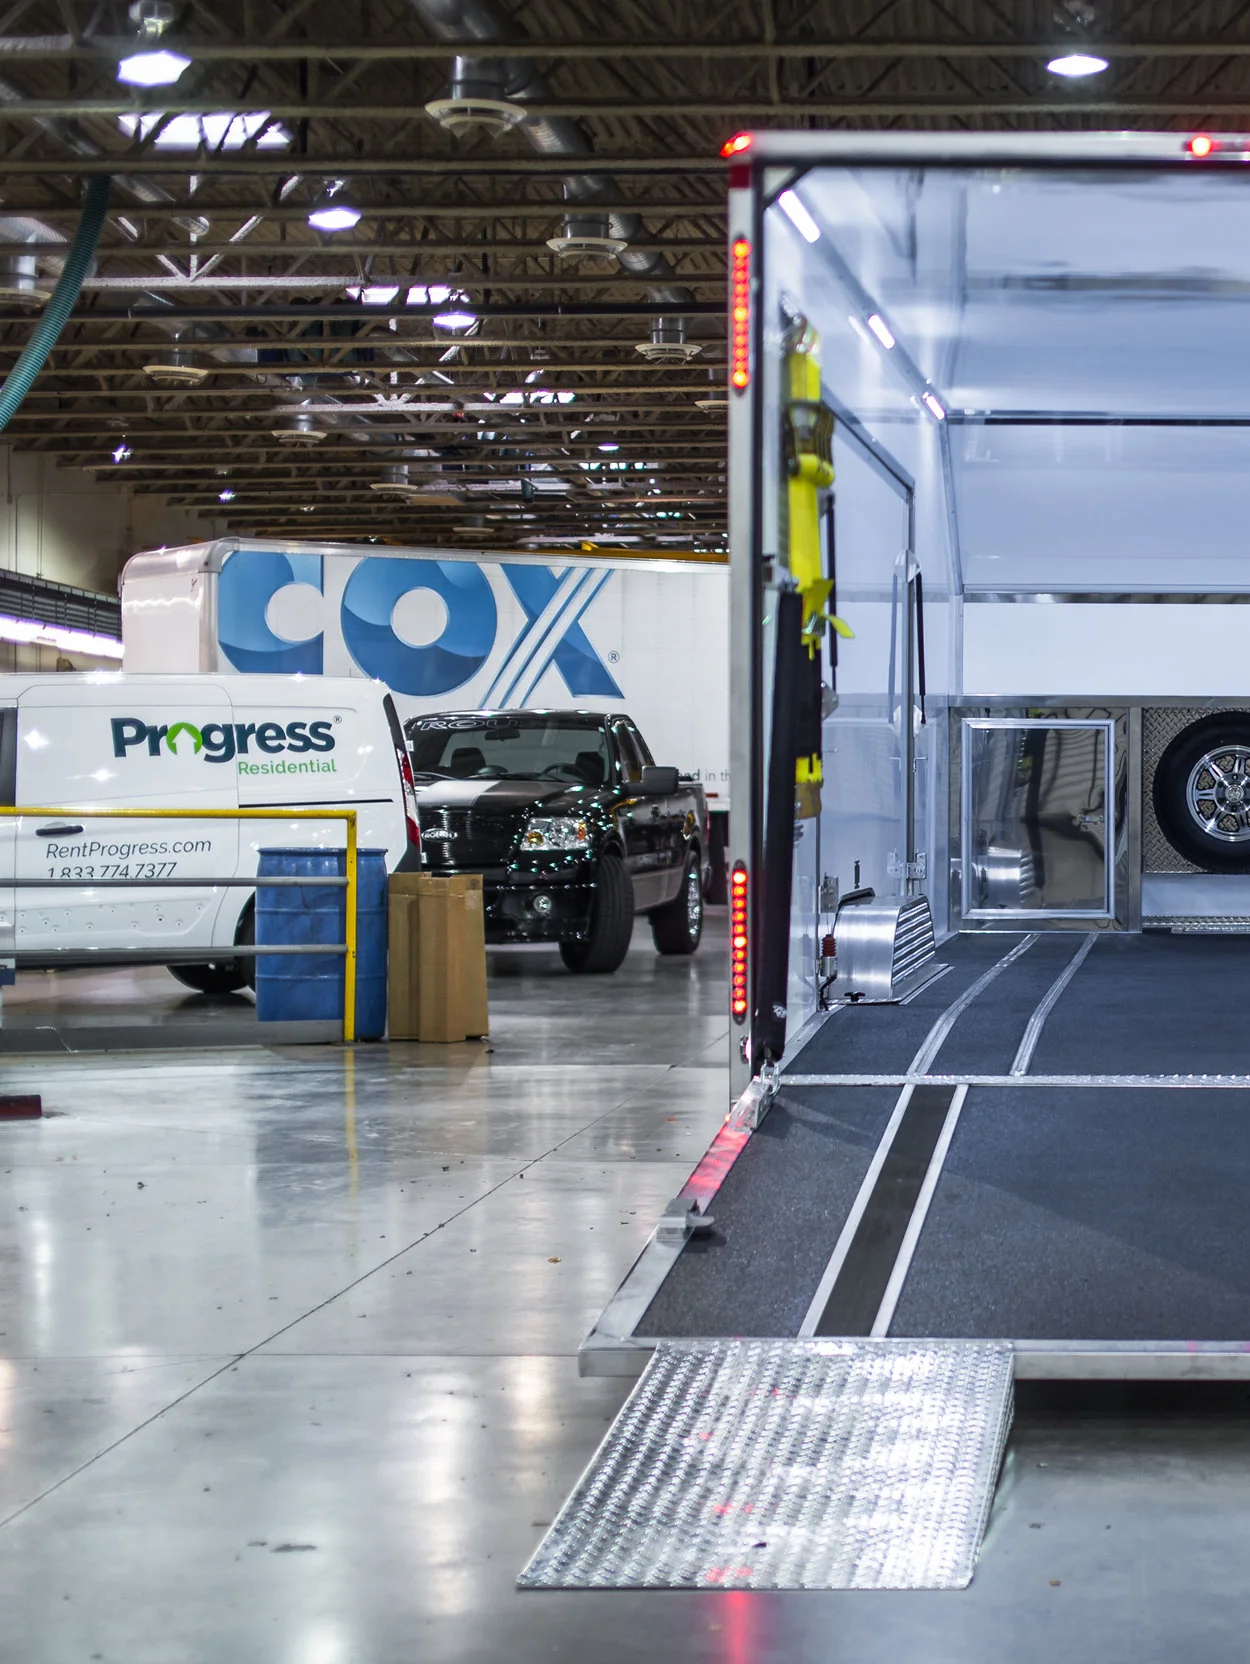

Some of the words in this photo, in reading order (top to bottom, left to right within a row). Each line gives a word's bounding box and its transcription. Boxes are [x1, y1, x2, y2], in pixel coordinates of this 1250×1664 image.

[218, 551, 625, 709] COX
[110, 718, 336, 763] Progress
[238, 759, 337, 775] Residential
[46, 840, 211, 859] RentProgress.com
